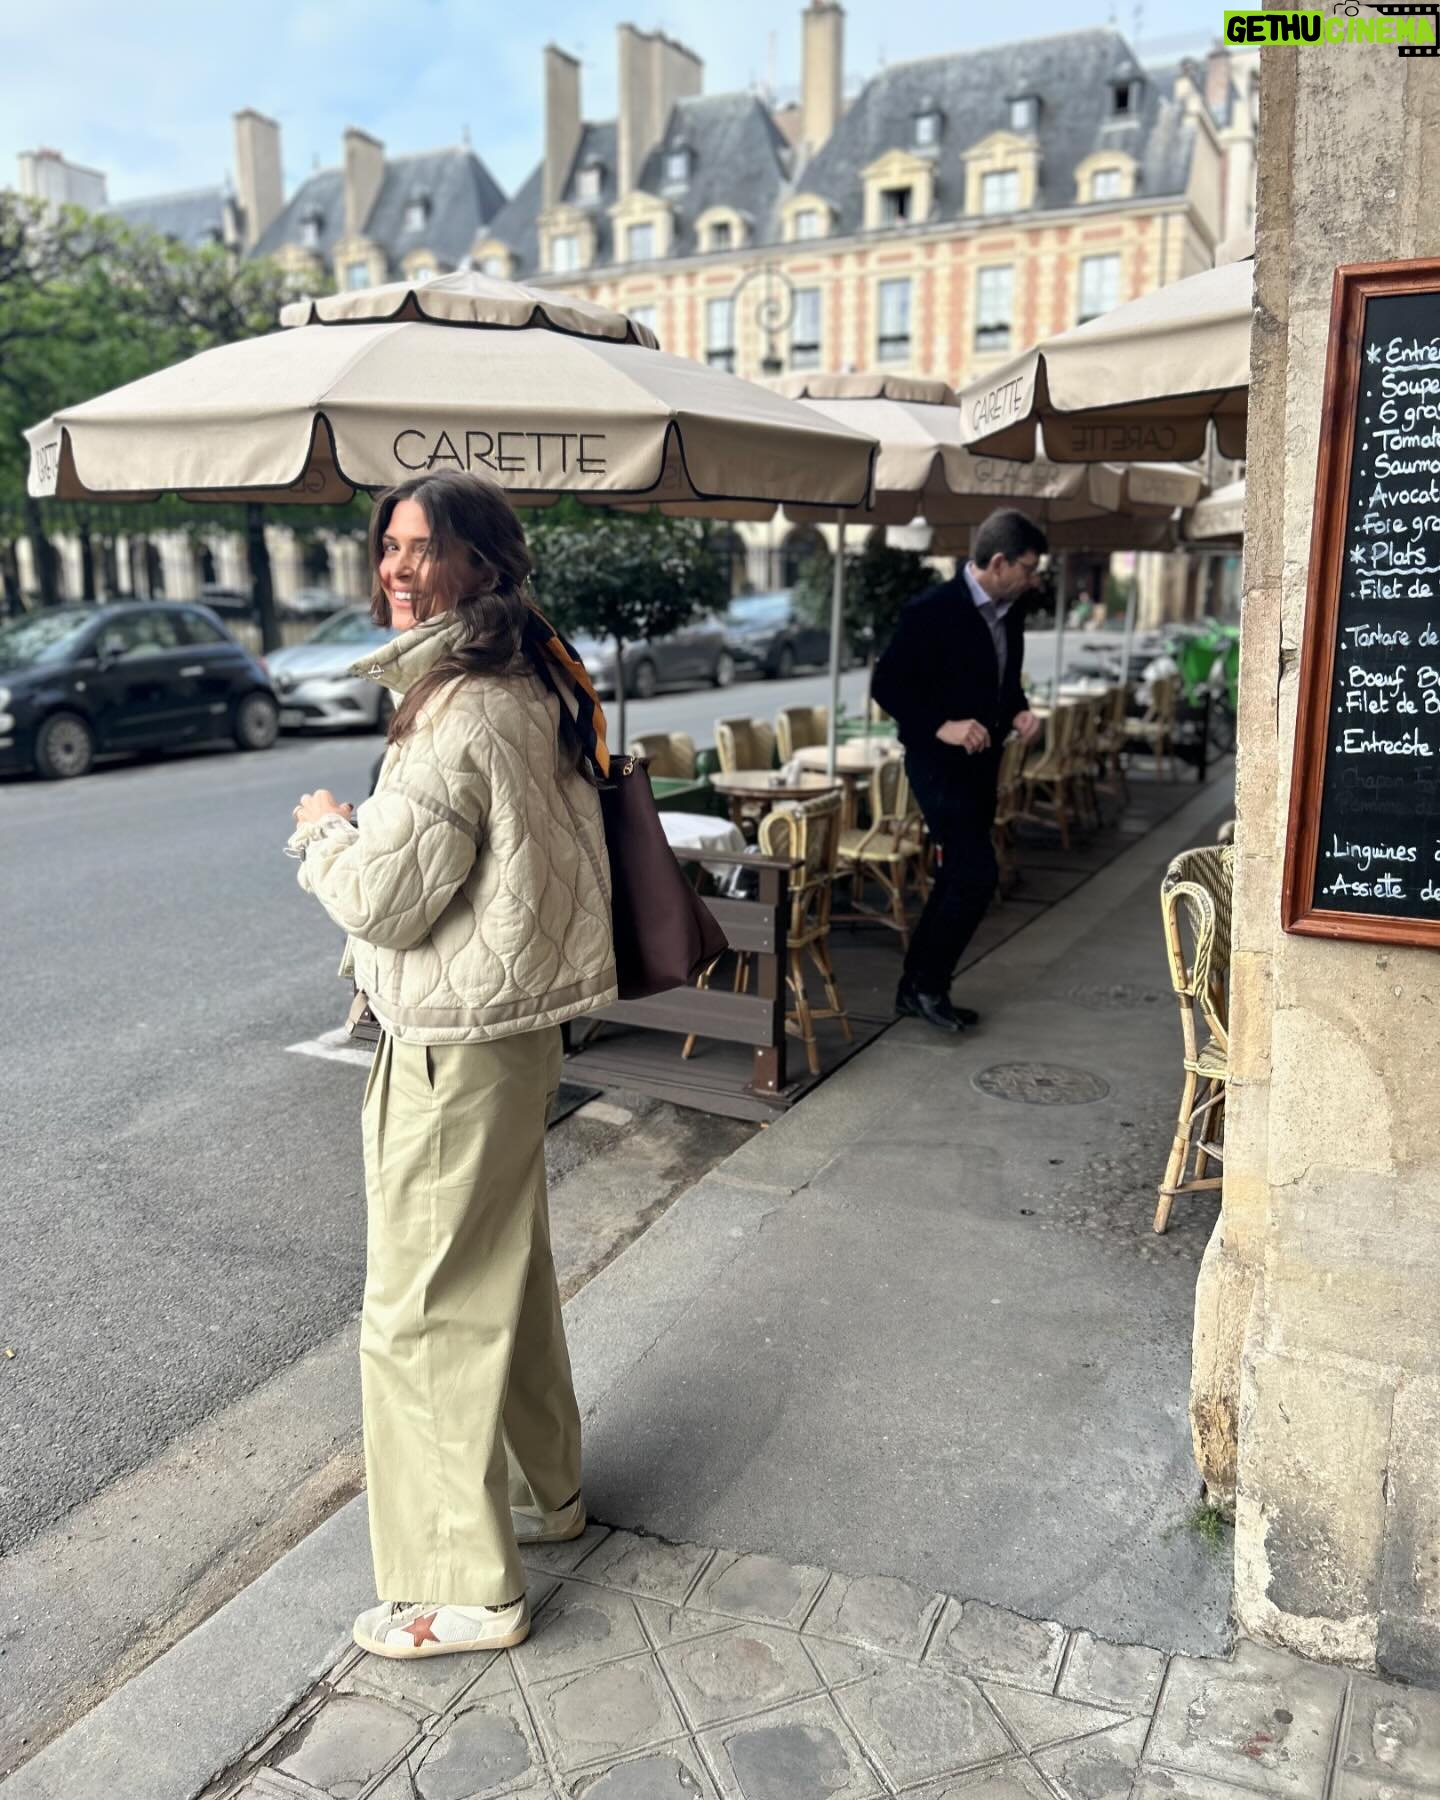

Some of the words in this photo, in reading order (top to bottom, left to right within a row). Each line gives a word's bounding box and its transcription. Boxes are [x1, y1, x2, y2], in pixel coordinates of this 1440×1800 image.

[1386, 337, 1440, 364] Entré
[1382, 373, 1440, 404] Soupe
[972, 376, 1024, 431] CARETTE
[1379, 400, 1398, 424] 6
[393, 429, 607, 474] CARETTE
[1369, 478, 1440, 508] Avocat
[1362, 512, 1408, 535] Foie
[1370, 541, 1426, 569] Plats
[1360, 577, 1403, 600] Filet
[1407, 578, 1434, 599] de
[1345, 623, 1411, 648] Tartare
[1418, 622, 1440, 647] de
[1417, 666, 1440, 688] B
[1346, 689, 1389, 714] Filet
[1396, 691, 1418, 714] de
[1423, 689, 1440, 714] B
[1343, 727, 1434, 757] Entrecôte
[1333, 833, 1417, 871] Linguines
[1329, 872, 1407, 898] Assiette
